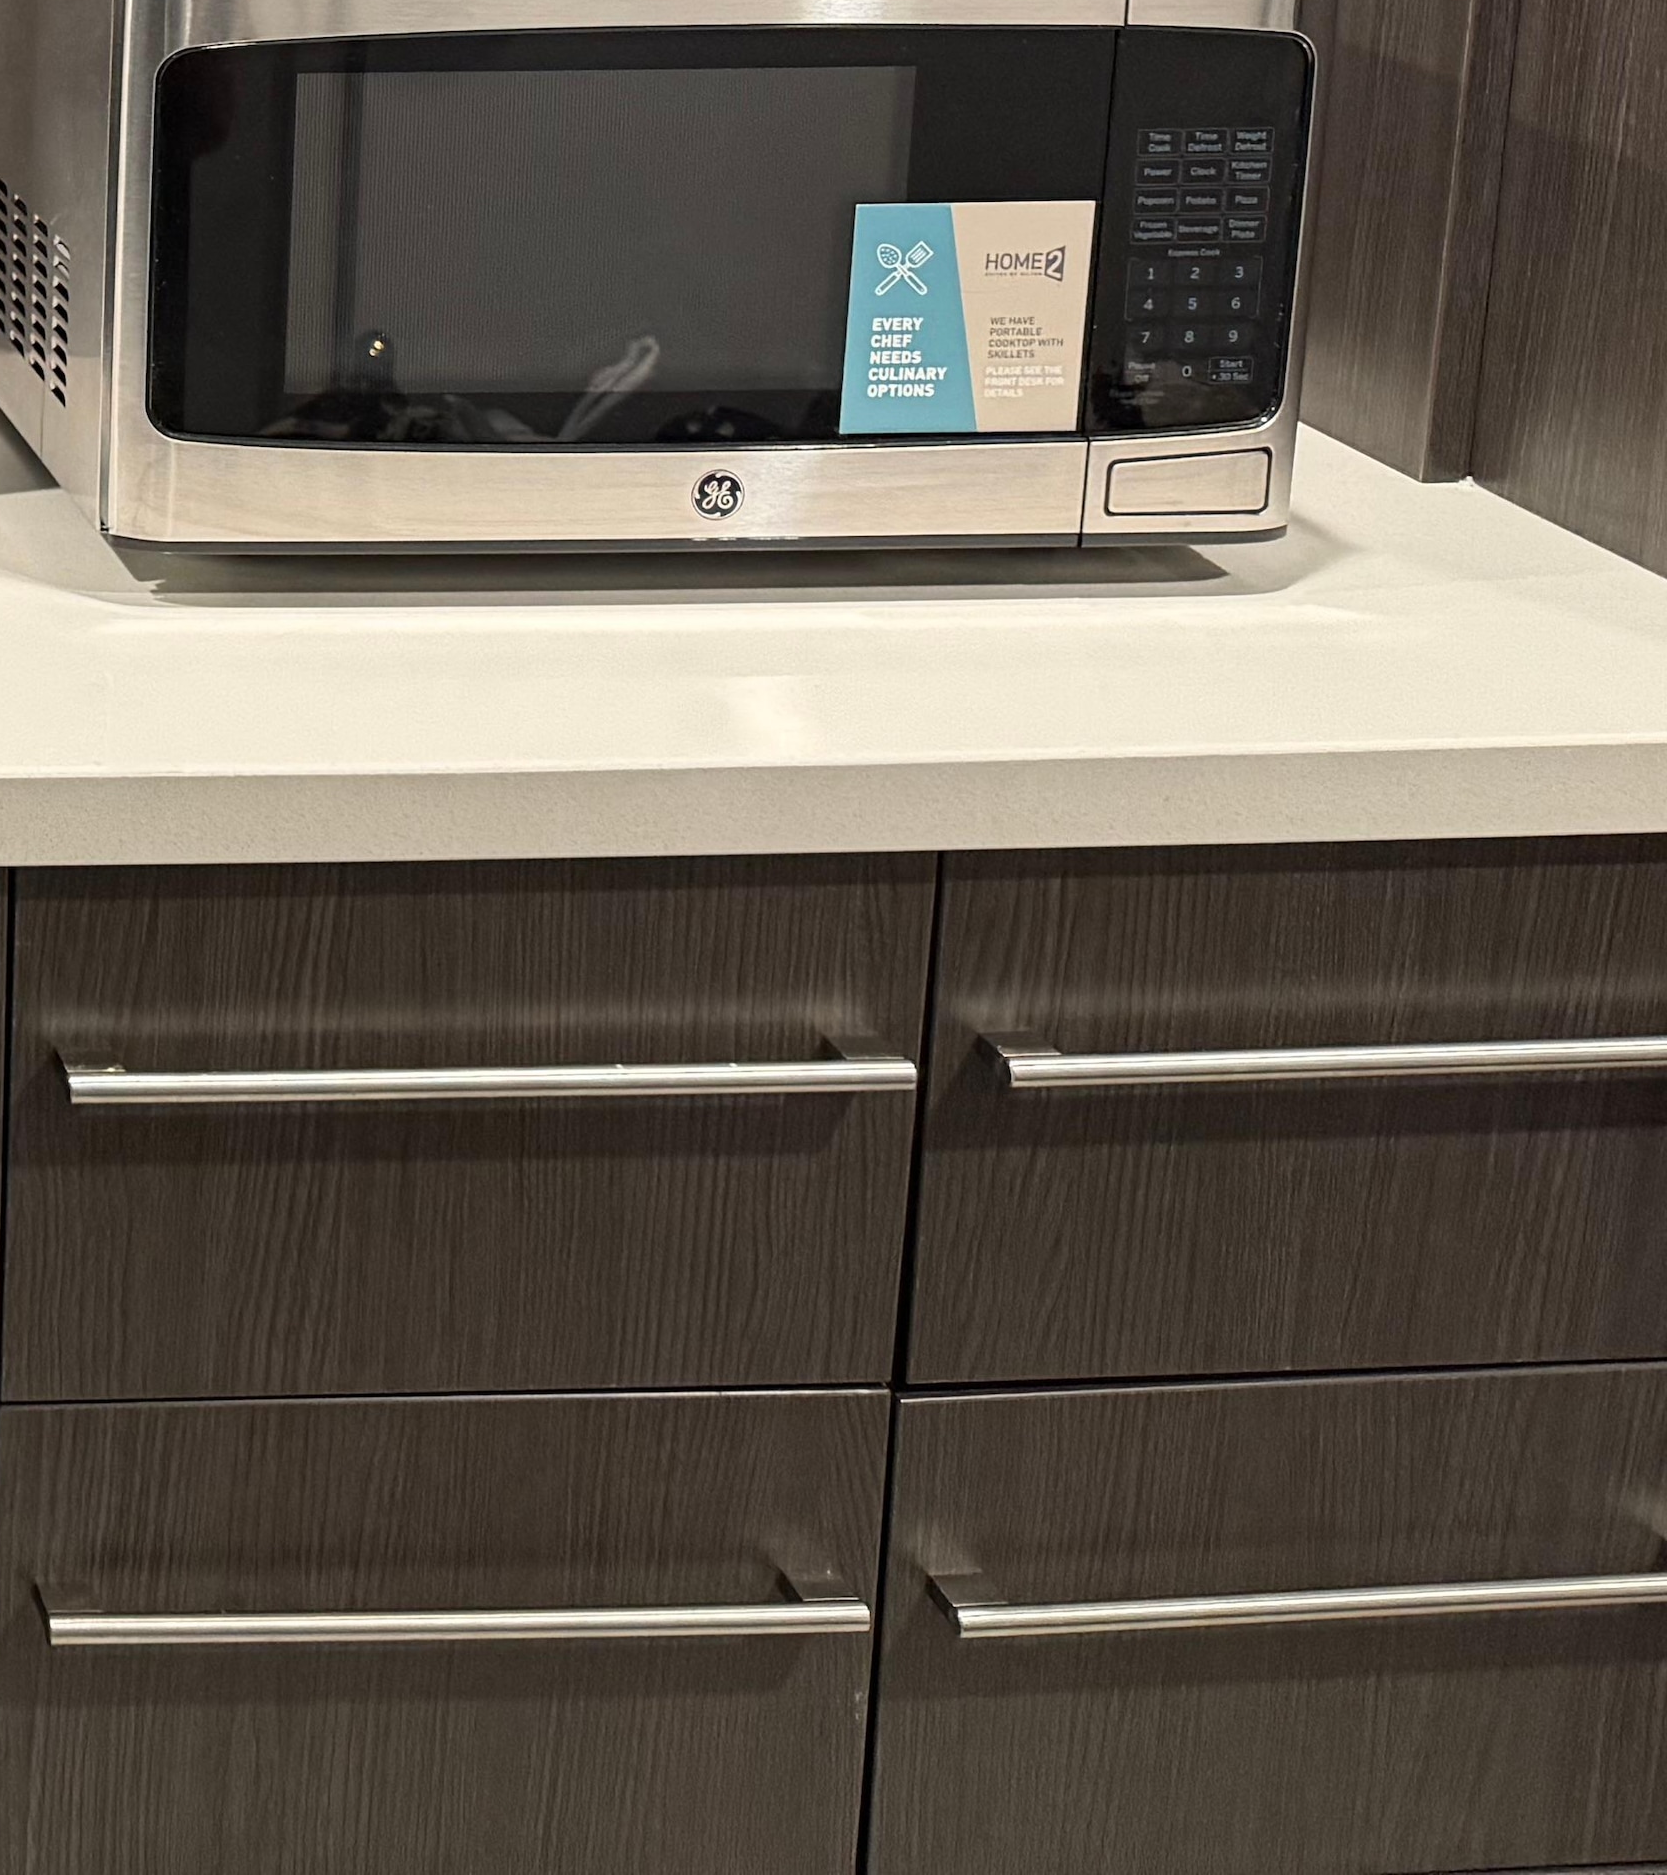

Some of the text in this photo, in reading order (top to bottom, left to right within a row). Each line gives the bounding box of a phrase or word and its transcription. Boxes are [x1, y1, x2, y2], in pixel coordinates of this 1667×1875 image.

[1190, 167, 1216, 175] Clock
[1147, 267, 1155, 280] 1
[1190, 267, 1200, 279] 2
[1234, 266, 1244, 278] 3
[1143, 298, 1154, 310] 4
[1187, 297, 1197, 310] 5
[1231, 296, 1241, 309] 6
[872, 317, 923, 331] EVERY
[990, 317, 1035, 325] WE HAVE
[989, 327, 1043, 336] PORTABLE
[1141, 331, 1151, 343] 7
[1184, 330, 1194, 343] 8
[1228, 330, 1238, 342] 9
[871, 334, 912, 348] CHEF
[988, 338, 1064, 348] COOKTOP WITH
[870, 351, 922, 365] NEEDS
[987, 350, 1035, 359] SKILLETS
[868, 367, 948, 381] CULINARY
[1181, 365, 1192, 377] 0
[867, 384, 935, 398] OPTIONS
